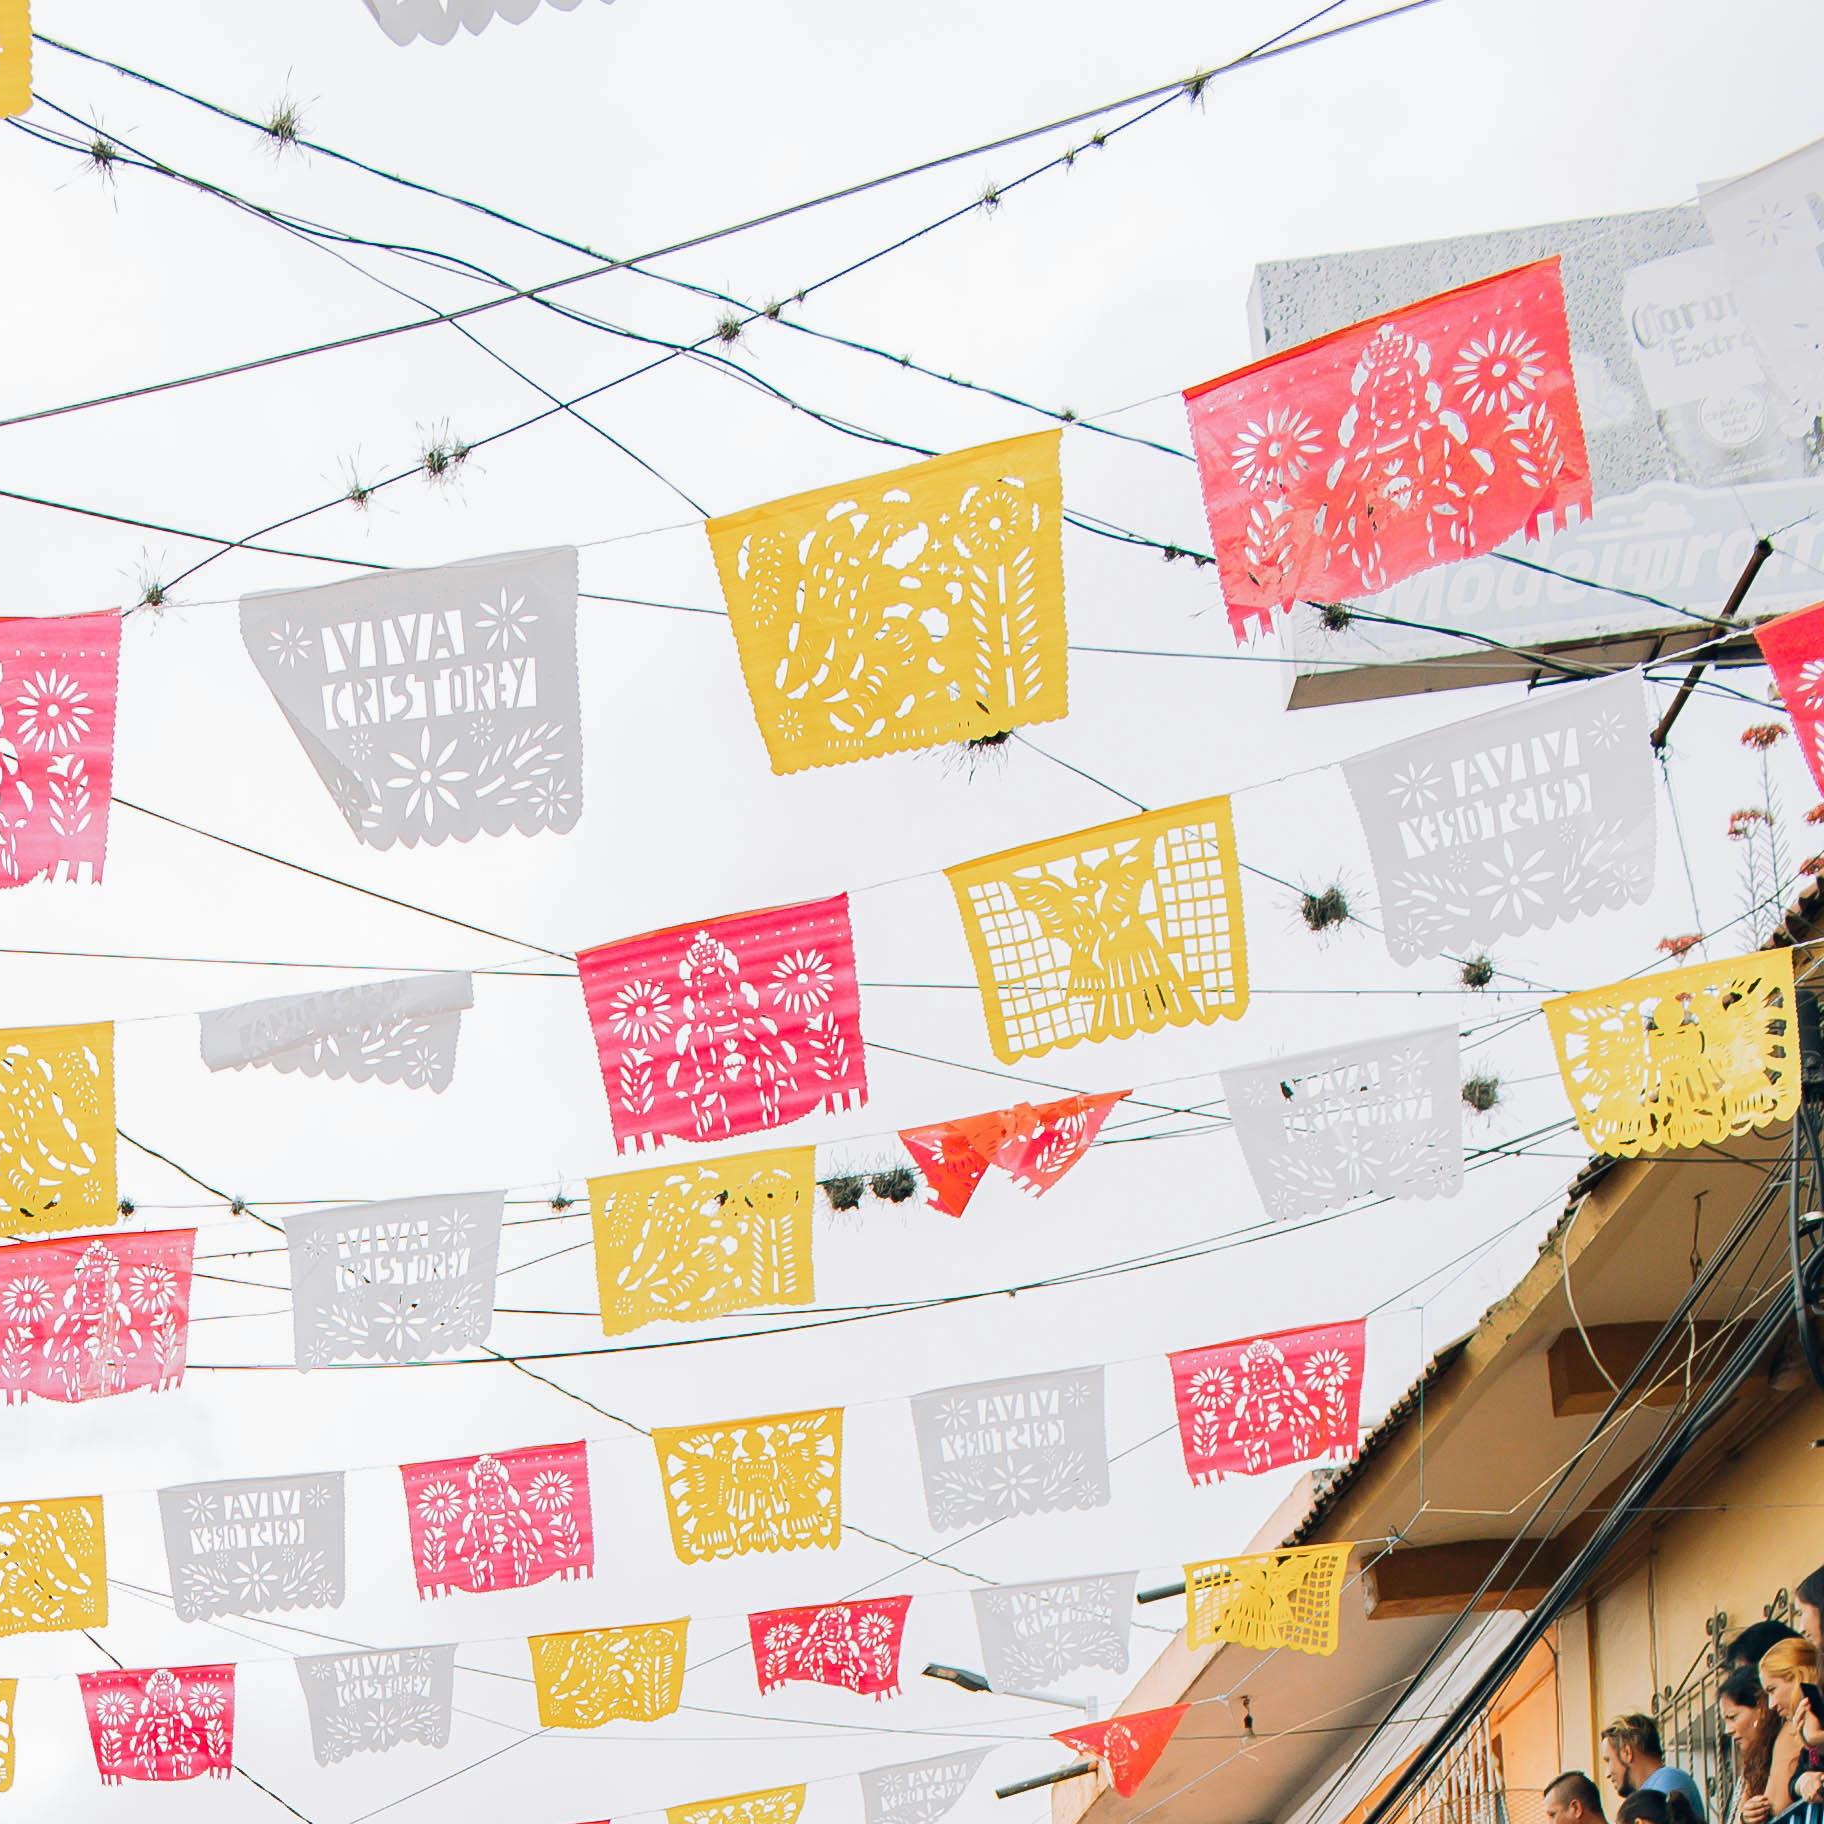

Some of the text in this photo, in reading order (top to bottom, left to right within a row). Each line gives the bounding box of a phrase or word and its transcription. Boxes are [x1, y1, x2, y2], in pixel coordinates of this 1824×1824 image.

[321, 609, 465, 674] VIVA
[336, 1219, 428, 1259] VIVA
[336, 1652, 401, 1680] VIVA
